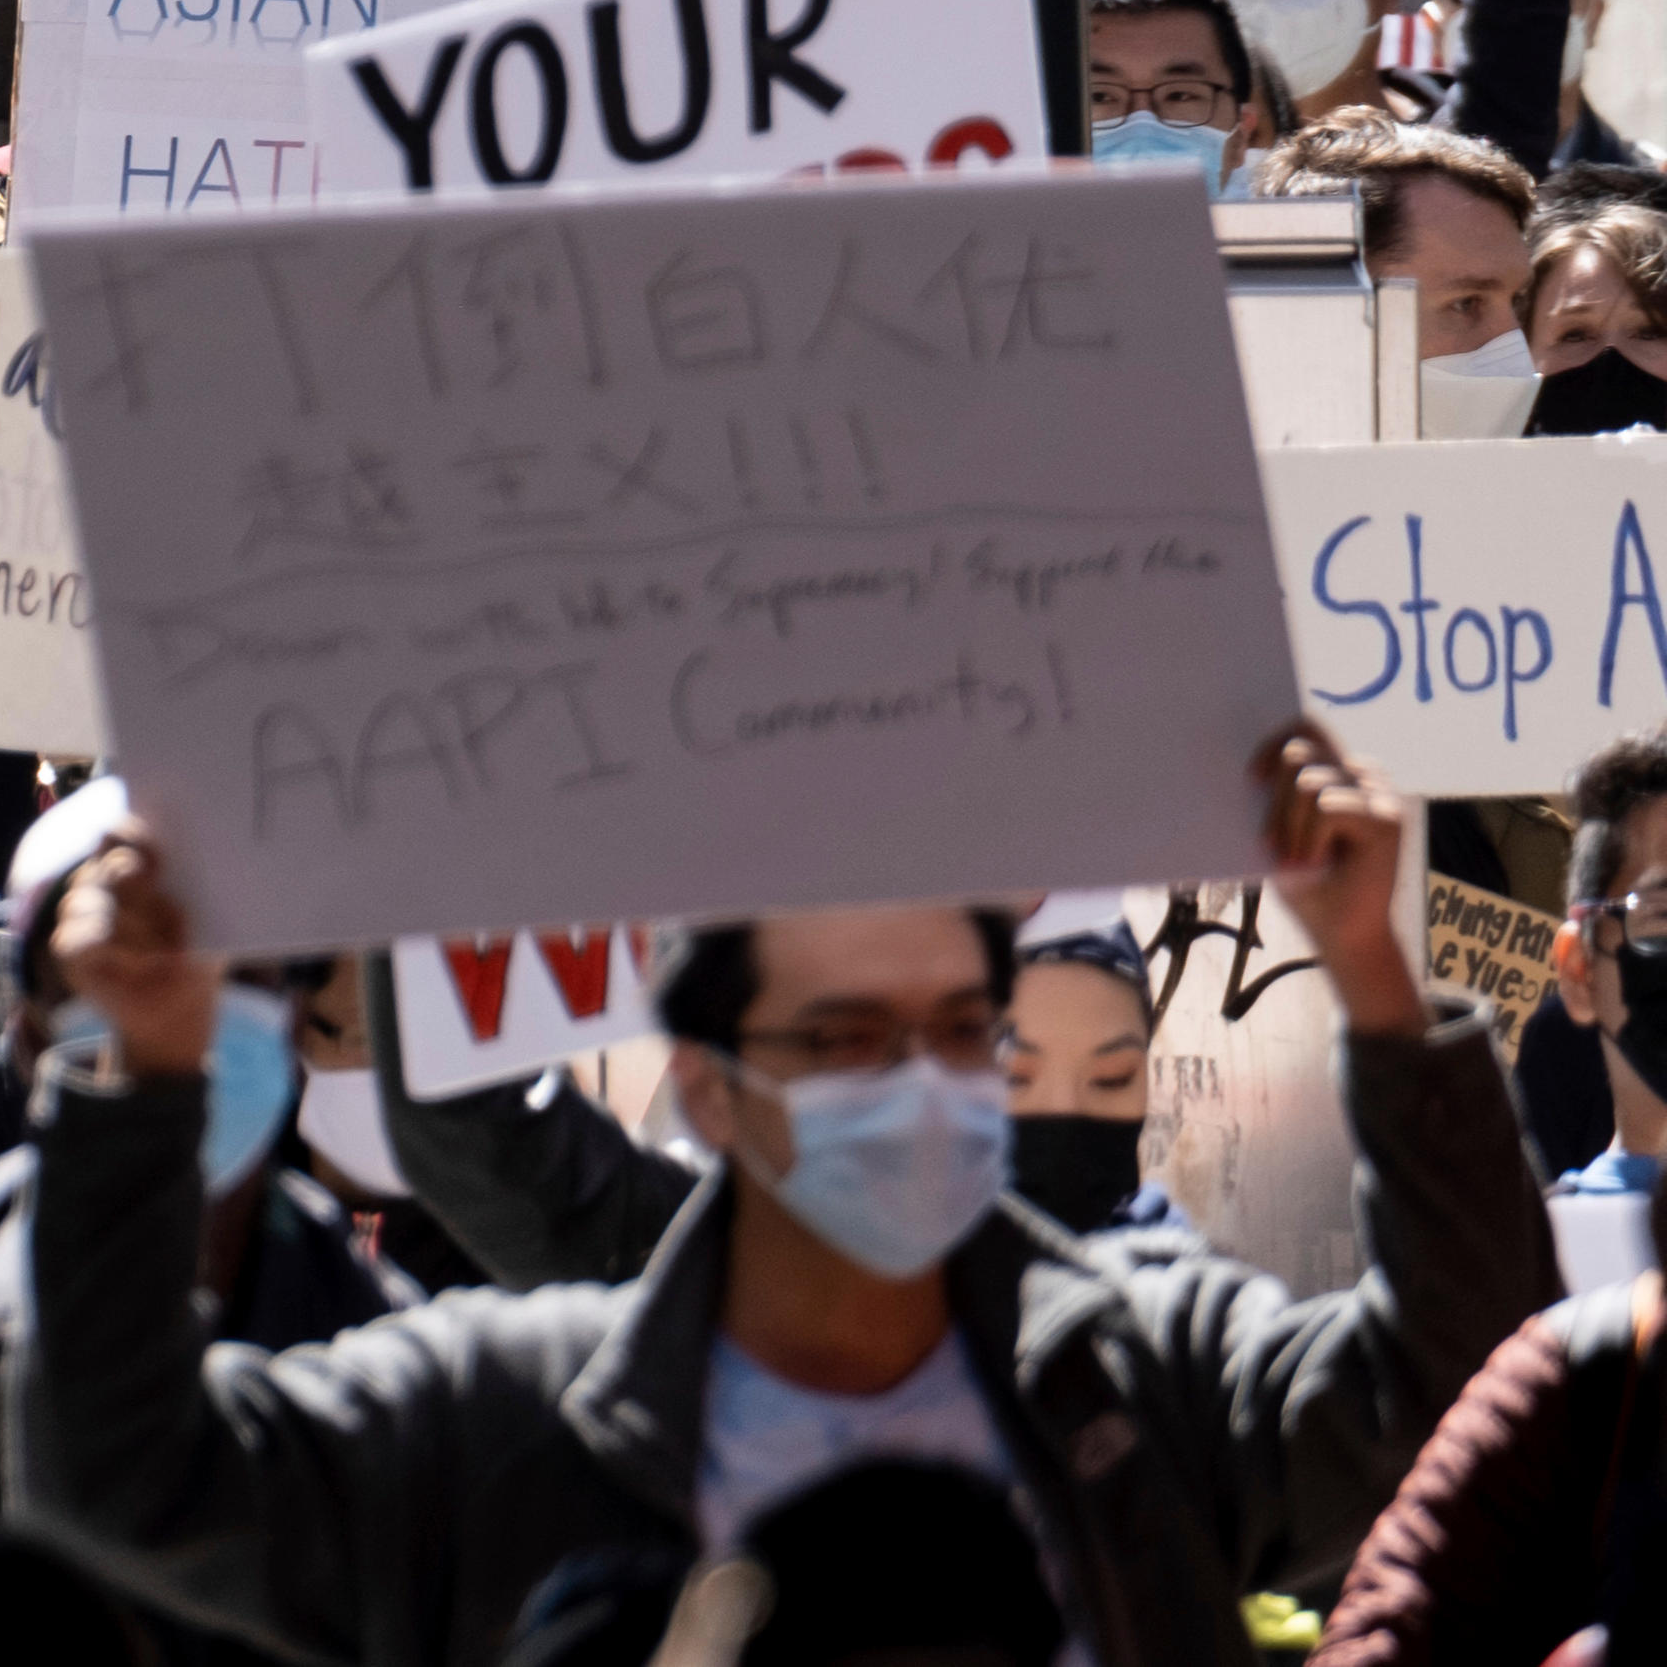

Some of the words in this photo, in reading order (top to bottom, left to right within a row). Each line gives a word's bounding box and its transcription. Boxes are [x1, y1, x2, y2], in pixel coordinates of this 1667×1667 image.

[1309, 513, 1553, 742] Stop
[249, 657, 638, 840] AAPI
[669, 642, 1077, 761] Community!
